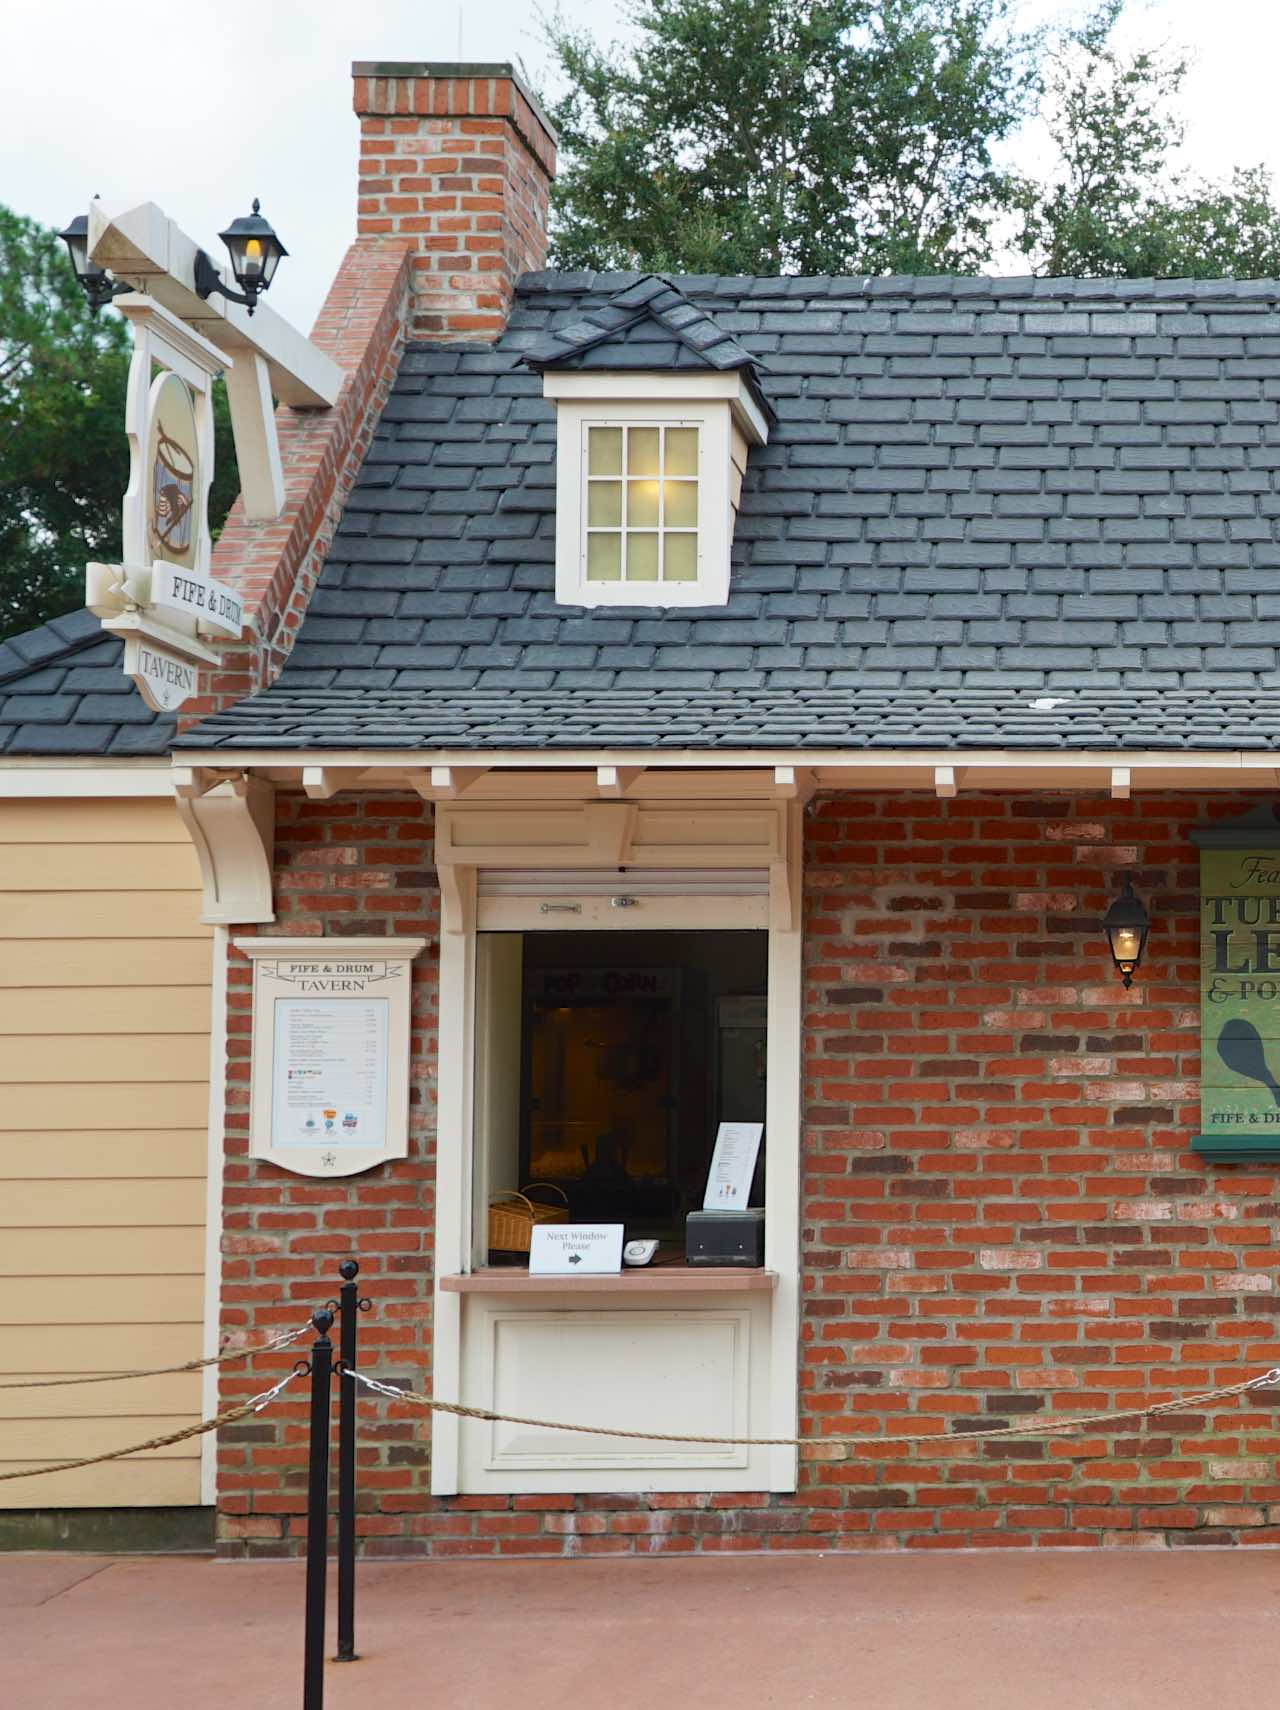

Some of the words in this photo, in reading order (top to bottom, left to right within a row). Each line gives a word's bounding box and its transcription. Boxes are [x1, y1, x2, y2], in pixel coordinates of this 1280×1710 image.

[172, 576, 206, 607] FIFE
[208, 590, 217, 612] &
[219, 595, 241, 626] DRUM
[142, 651, 194, 690] TAVERN
[290, 964, 319, 973] FIFE
[322, 964, 332, 973] &
[336, 964, 374, 973] DRUM
[297, 980, 366, 991] TAVERN
[1207, 977, 1234, 1004] &
[1211, 1113, 1245, 1124] FIFE
[1248, 1113, 1259, 1124] &
[546, 1231, 568, 1241] Next
[571, 1231, 607, 1241] Window
[562, 1241, 591, 1250] Please
